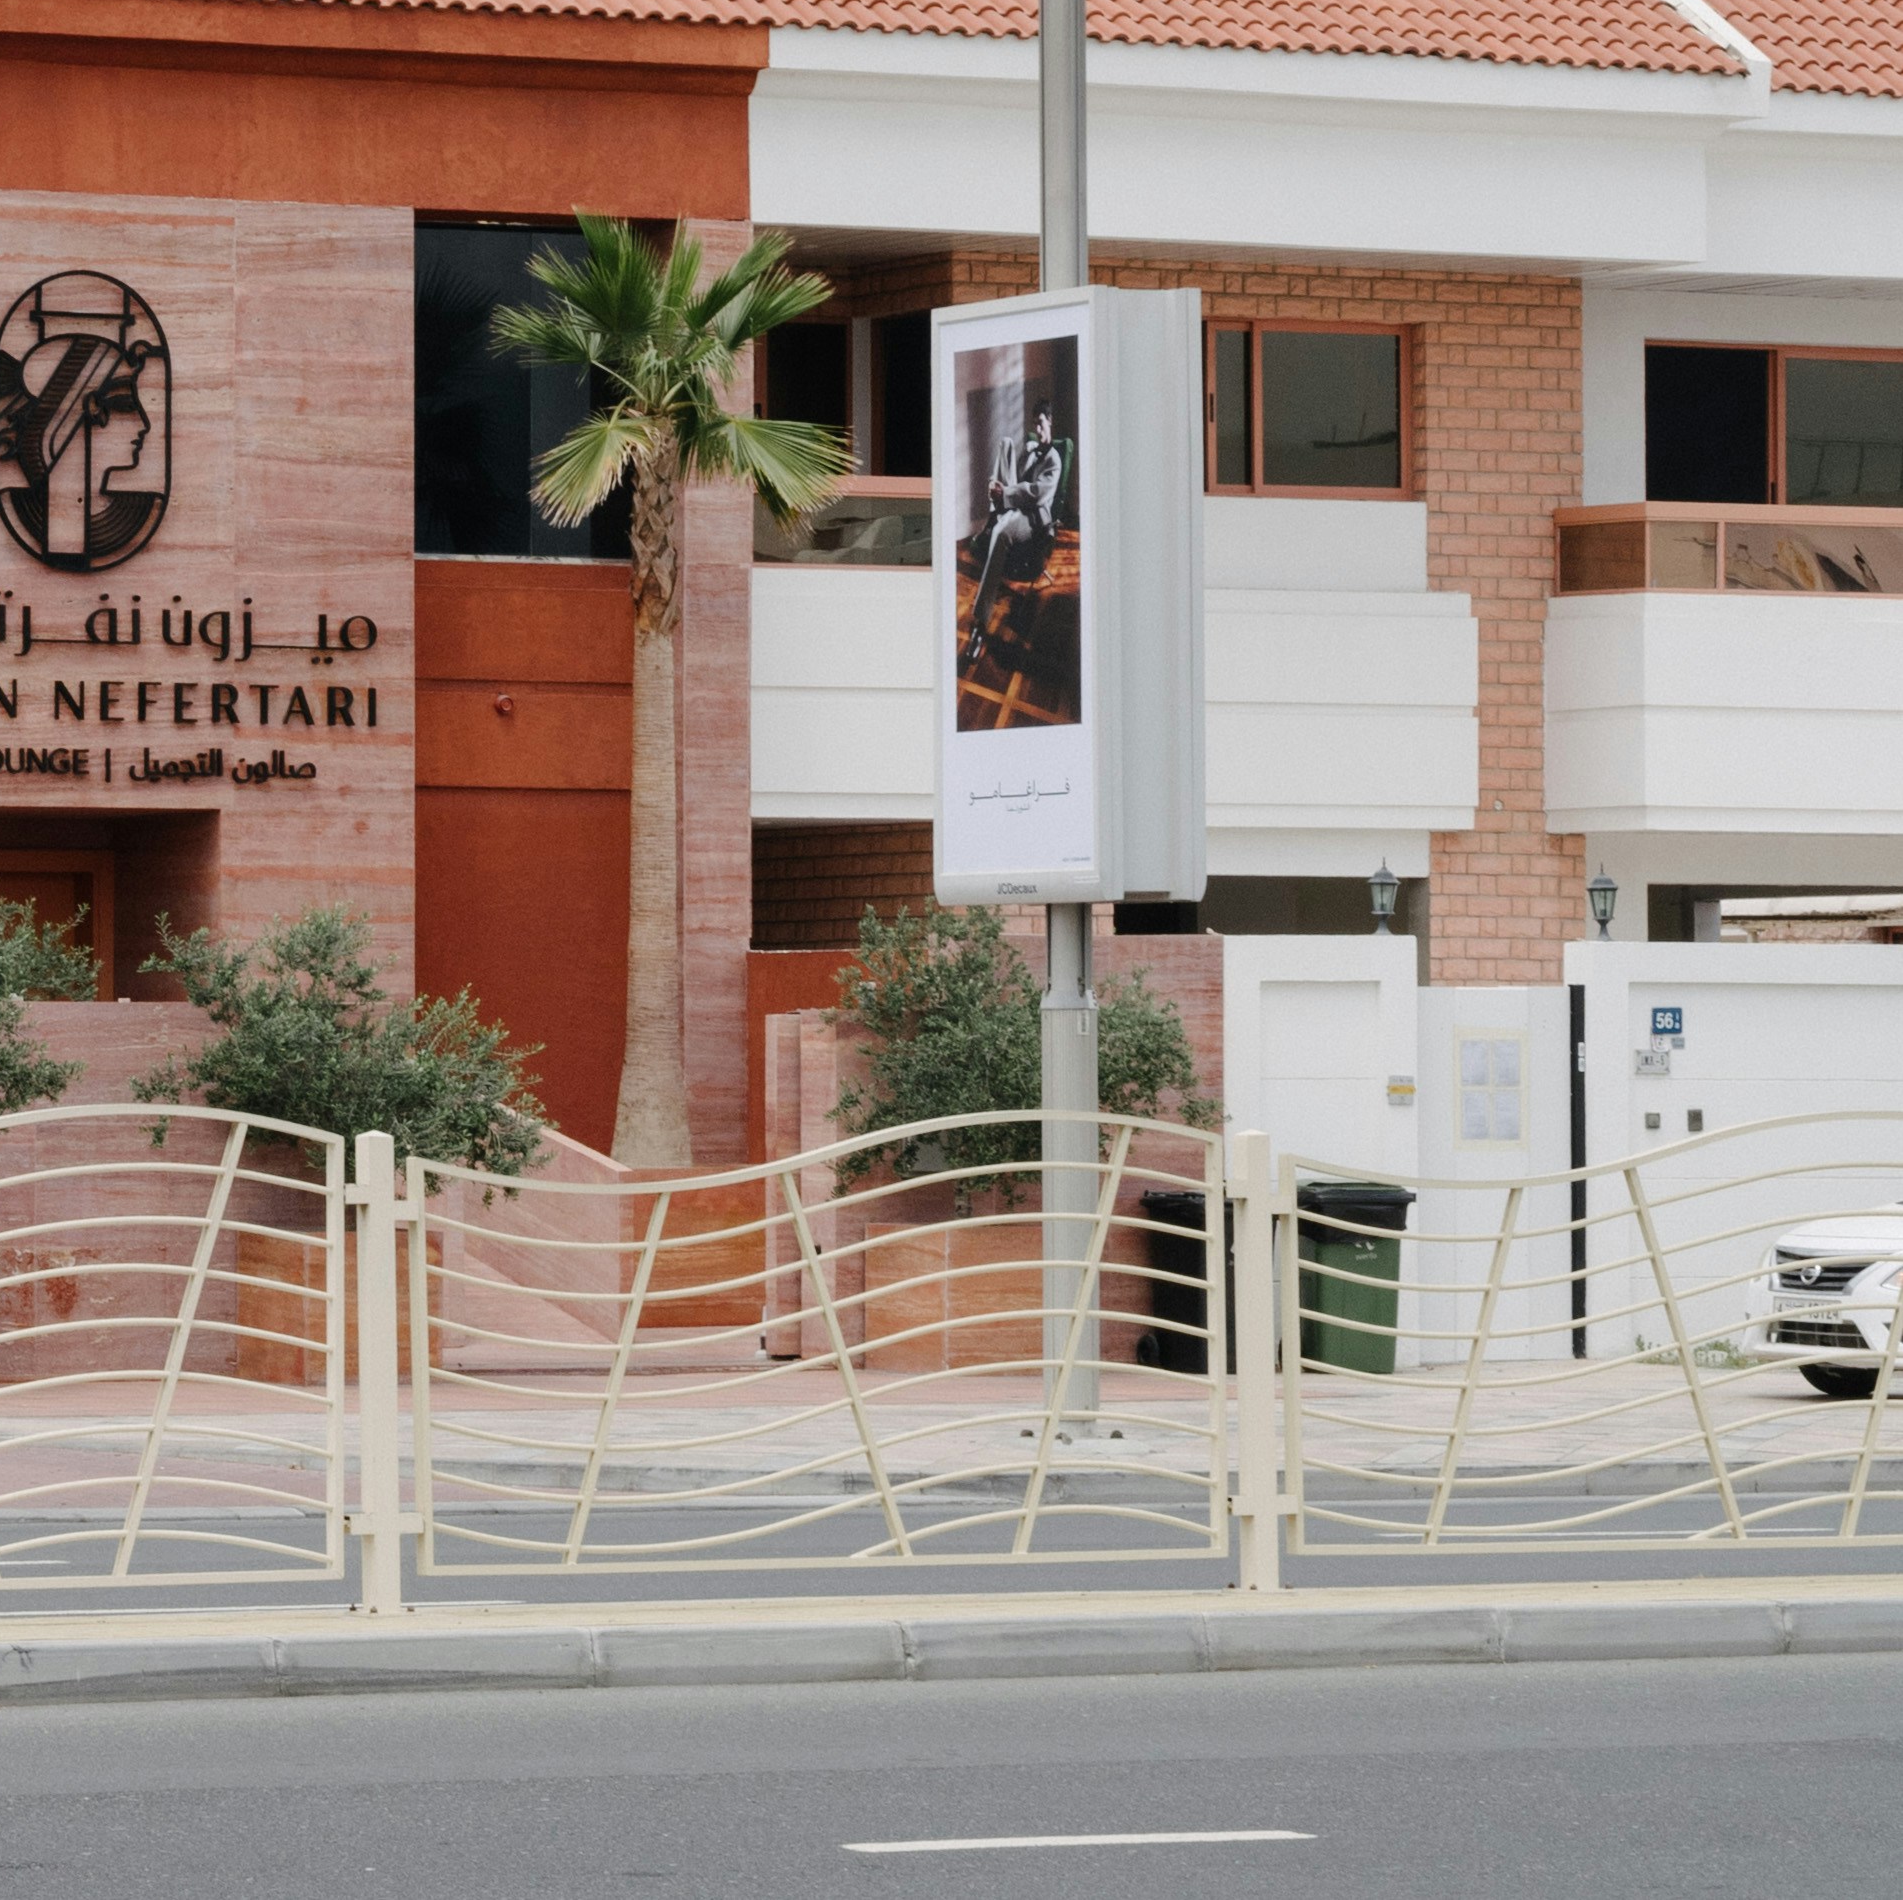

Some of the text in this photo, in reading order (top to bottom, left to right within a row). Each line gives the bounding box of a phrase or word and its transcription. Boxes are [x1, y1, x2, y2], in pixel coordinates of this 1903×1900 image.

[54, 680, 377, 727] NEFERTARI
[129, 747, 317, 784] صالون التجميل
[997, 883, 1039, 895] JCDecaux
[1655, 1012, 1674, 1029] 56
